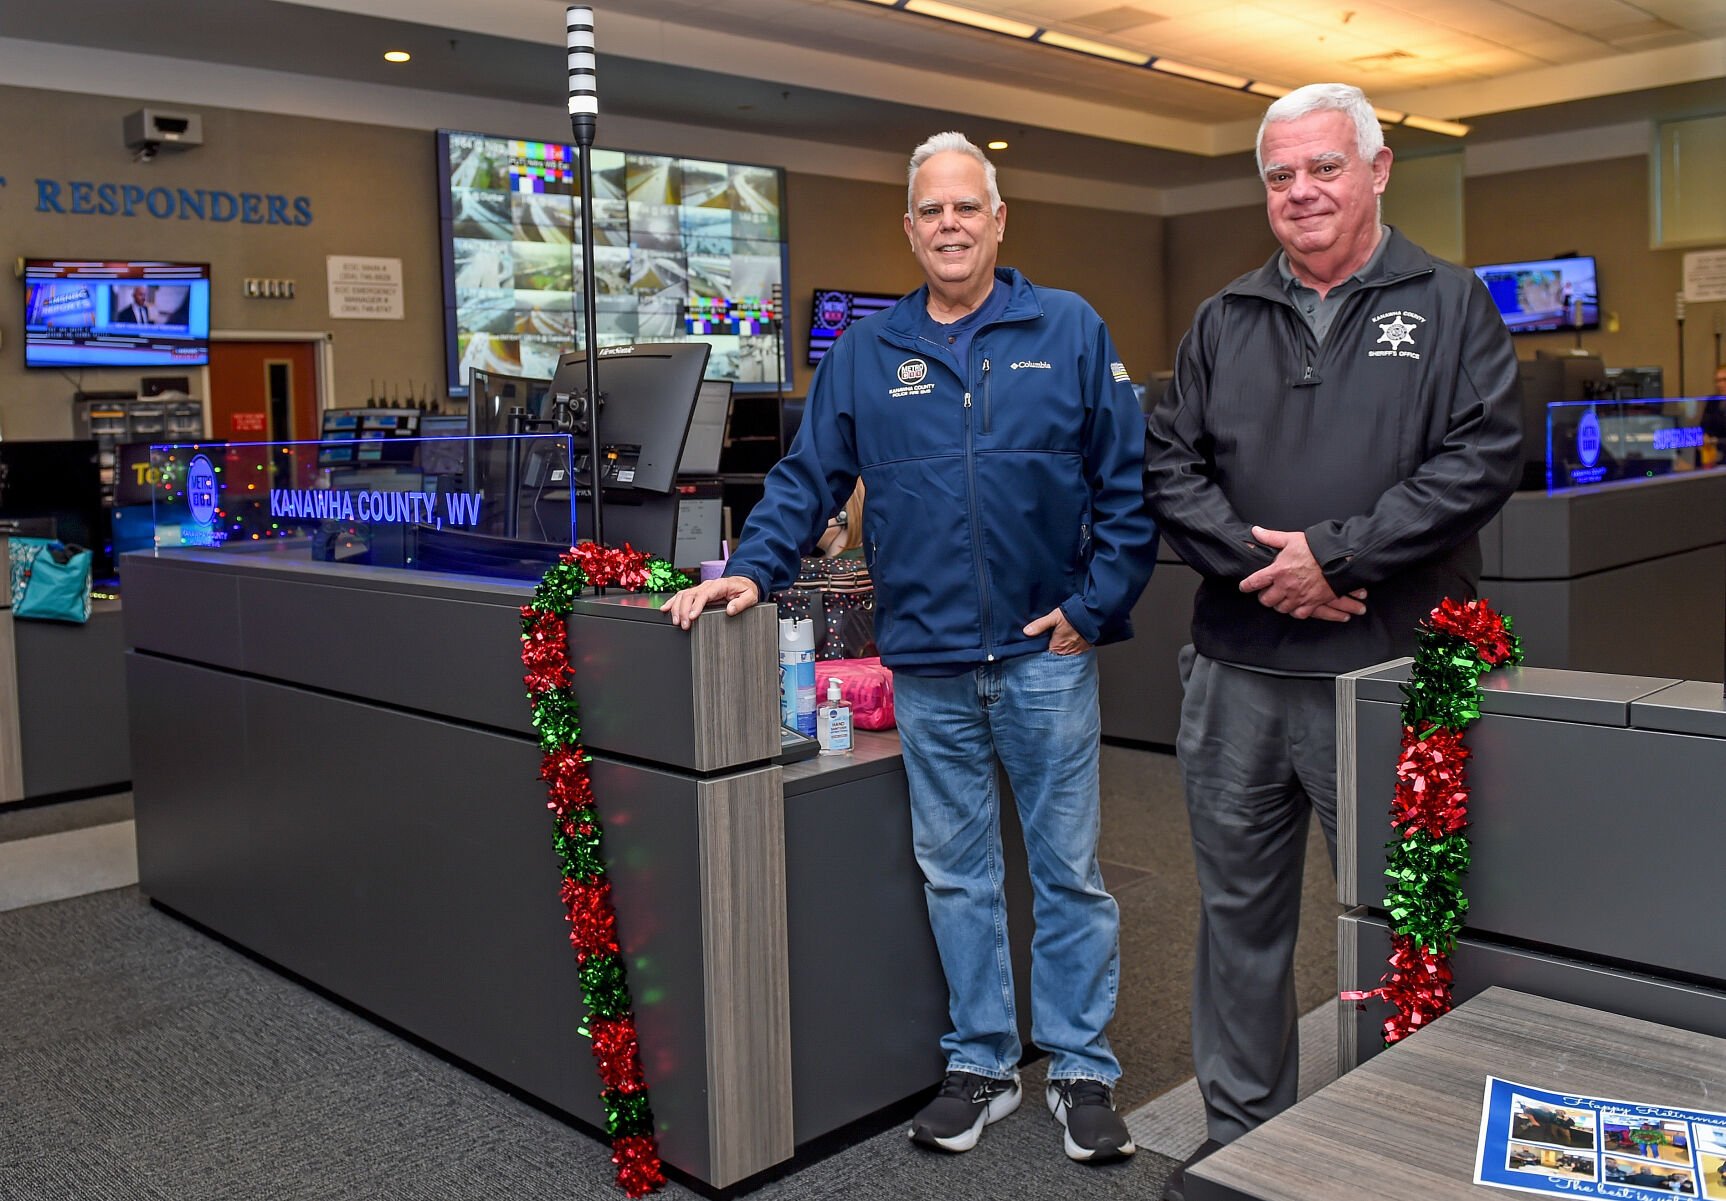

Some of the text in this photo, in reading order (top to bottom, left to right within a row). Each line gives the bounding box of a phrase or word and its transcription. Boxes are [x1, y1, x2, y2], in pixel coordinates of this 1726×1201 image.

[34, 178, 313, 226] RESPONDERS
[1399, 351, 1420, 359] OFFICE
[902, 364, 923, 372] METRO
[1018, 360, 1052, 369] Columbia
[270, 488, 481, 531] KANAWHA COUNTY, WV
[1563, 1097, 1631, 1115] Happy
[1549, 1176, 1594, 1193] The
[1597, 1182, 1635, 1199] best
